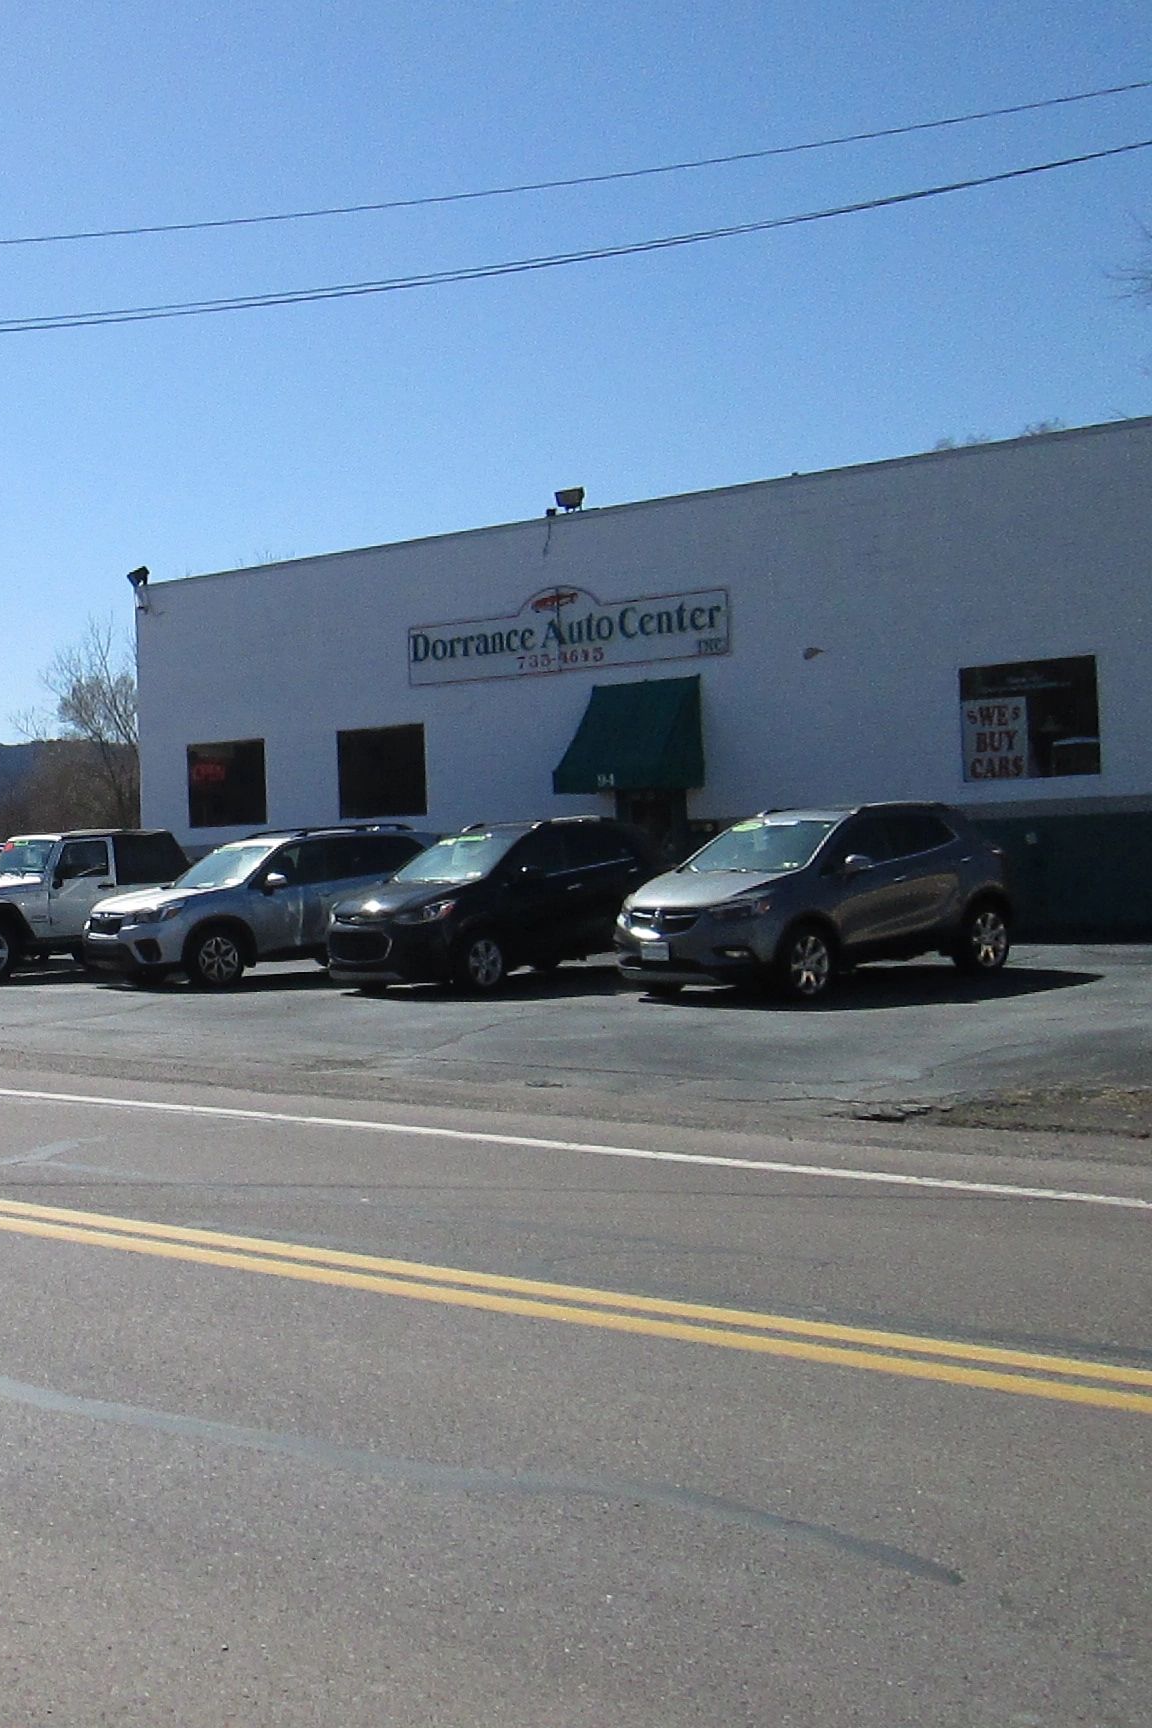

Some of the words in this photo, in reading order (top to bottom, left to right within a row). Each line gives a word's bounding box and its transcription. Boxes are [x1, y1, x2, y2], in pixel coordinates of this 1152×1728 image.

[410, 627, 535, 662] Dorrance
[540, 612, 614, 648] Auto
[618, 602, 723, 640] Center
[979, 706, 1008, 726] WE
[976, 730, 1019, 753] BUY
[970, 755, 1024, 778] CARS
